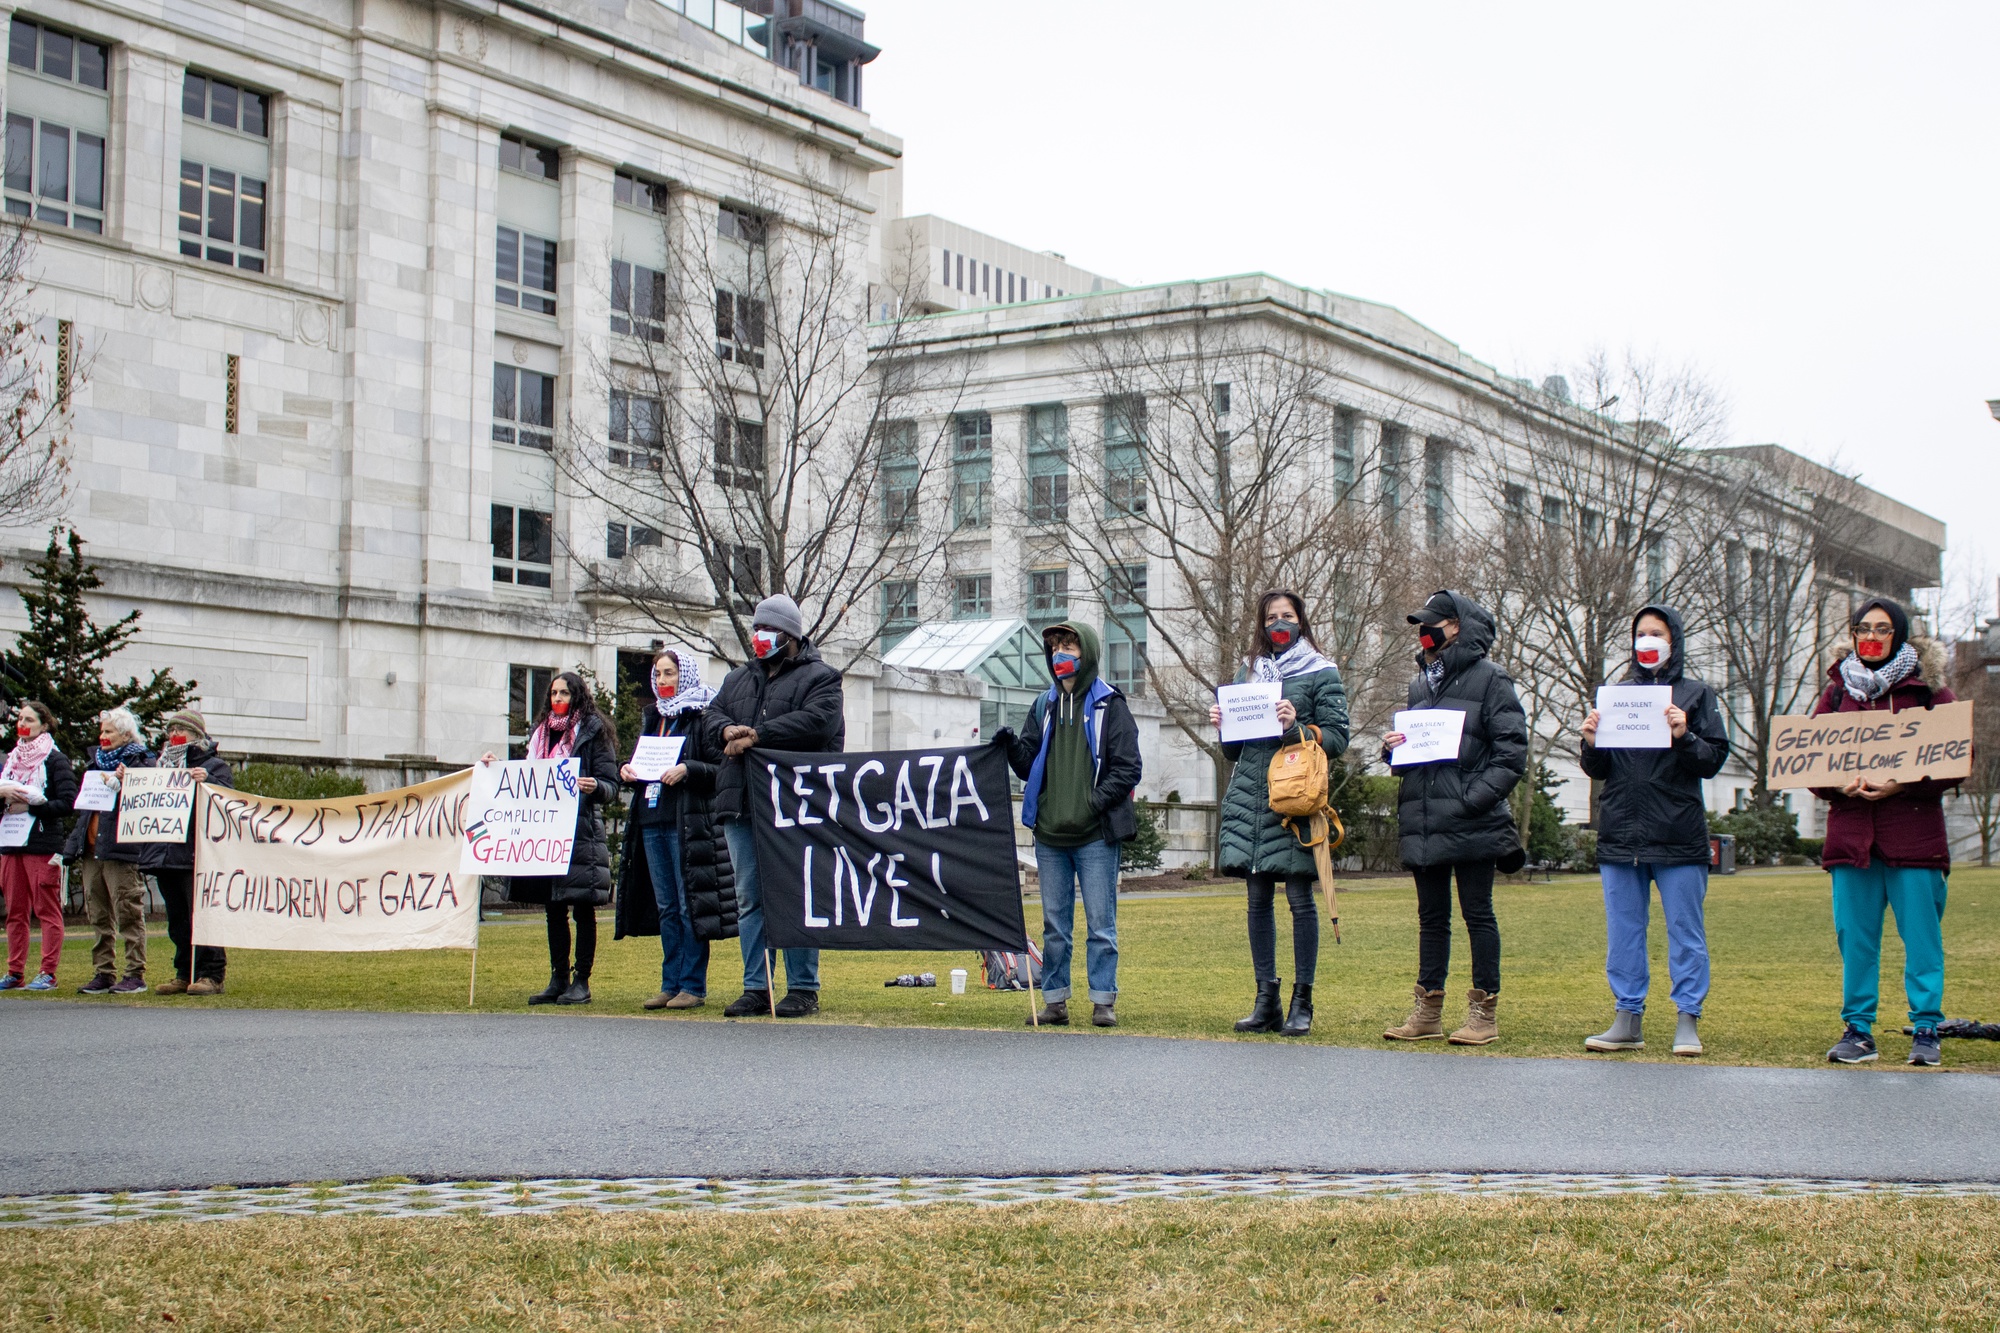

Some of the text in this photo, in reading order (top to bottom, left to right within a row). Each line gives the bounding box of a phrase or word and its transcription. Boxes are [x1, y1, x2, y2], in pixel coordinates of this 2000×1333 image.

[1227, 694, 1269, 704] HMS SILENCING
[1229, 704, 1260, 714] PROTESTERS
[1237, 713, 1265, 722] GENOCIDE
[1425, 720, 1446, 728] SILENT
[1411, 740, 1440, 750] GENOCIDE
[1775, 721, 1922, 752] GENOCIDE'S
[1772, 752, 1823, 778] NOT
[1828, 750, 1908, 773] WELCOME
[124, 770, 192, 788] There is NO
[494, 766, 561, 801] AMA
[120, 792, 189, 811] ANESTHESIA
[767, 755, 989, 833] LET GAZA
[205, 792, 470, 846] ISRAEL IS STARVING
[484, 808, 559, 823] COMPLICIT
[139, 816, 183, 836] GAZA
[510, 828, 520, 836] IN
[472, 834, 573, 864] GENOCIDE
[225, 869, 327, 922] CHILDREN
[337, 877, 370, 917] OF
[378, 870, 459, 916] GAZA
